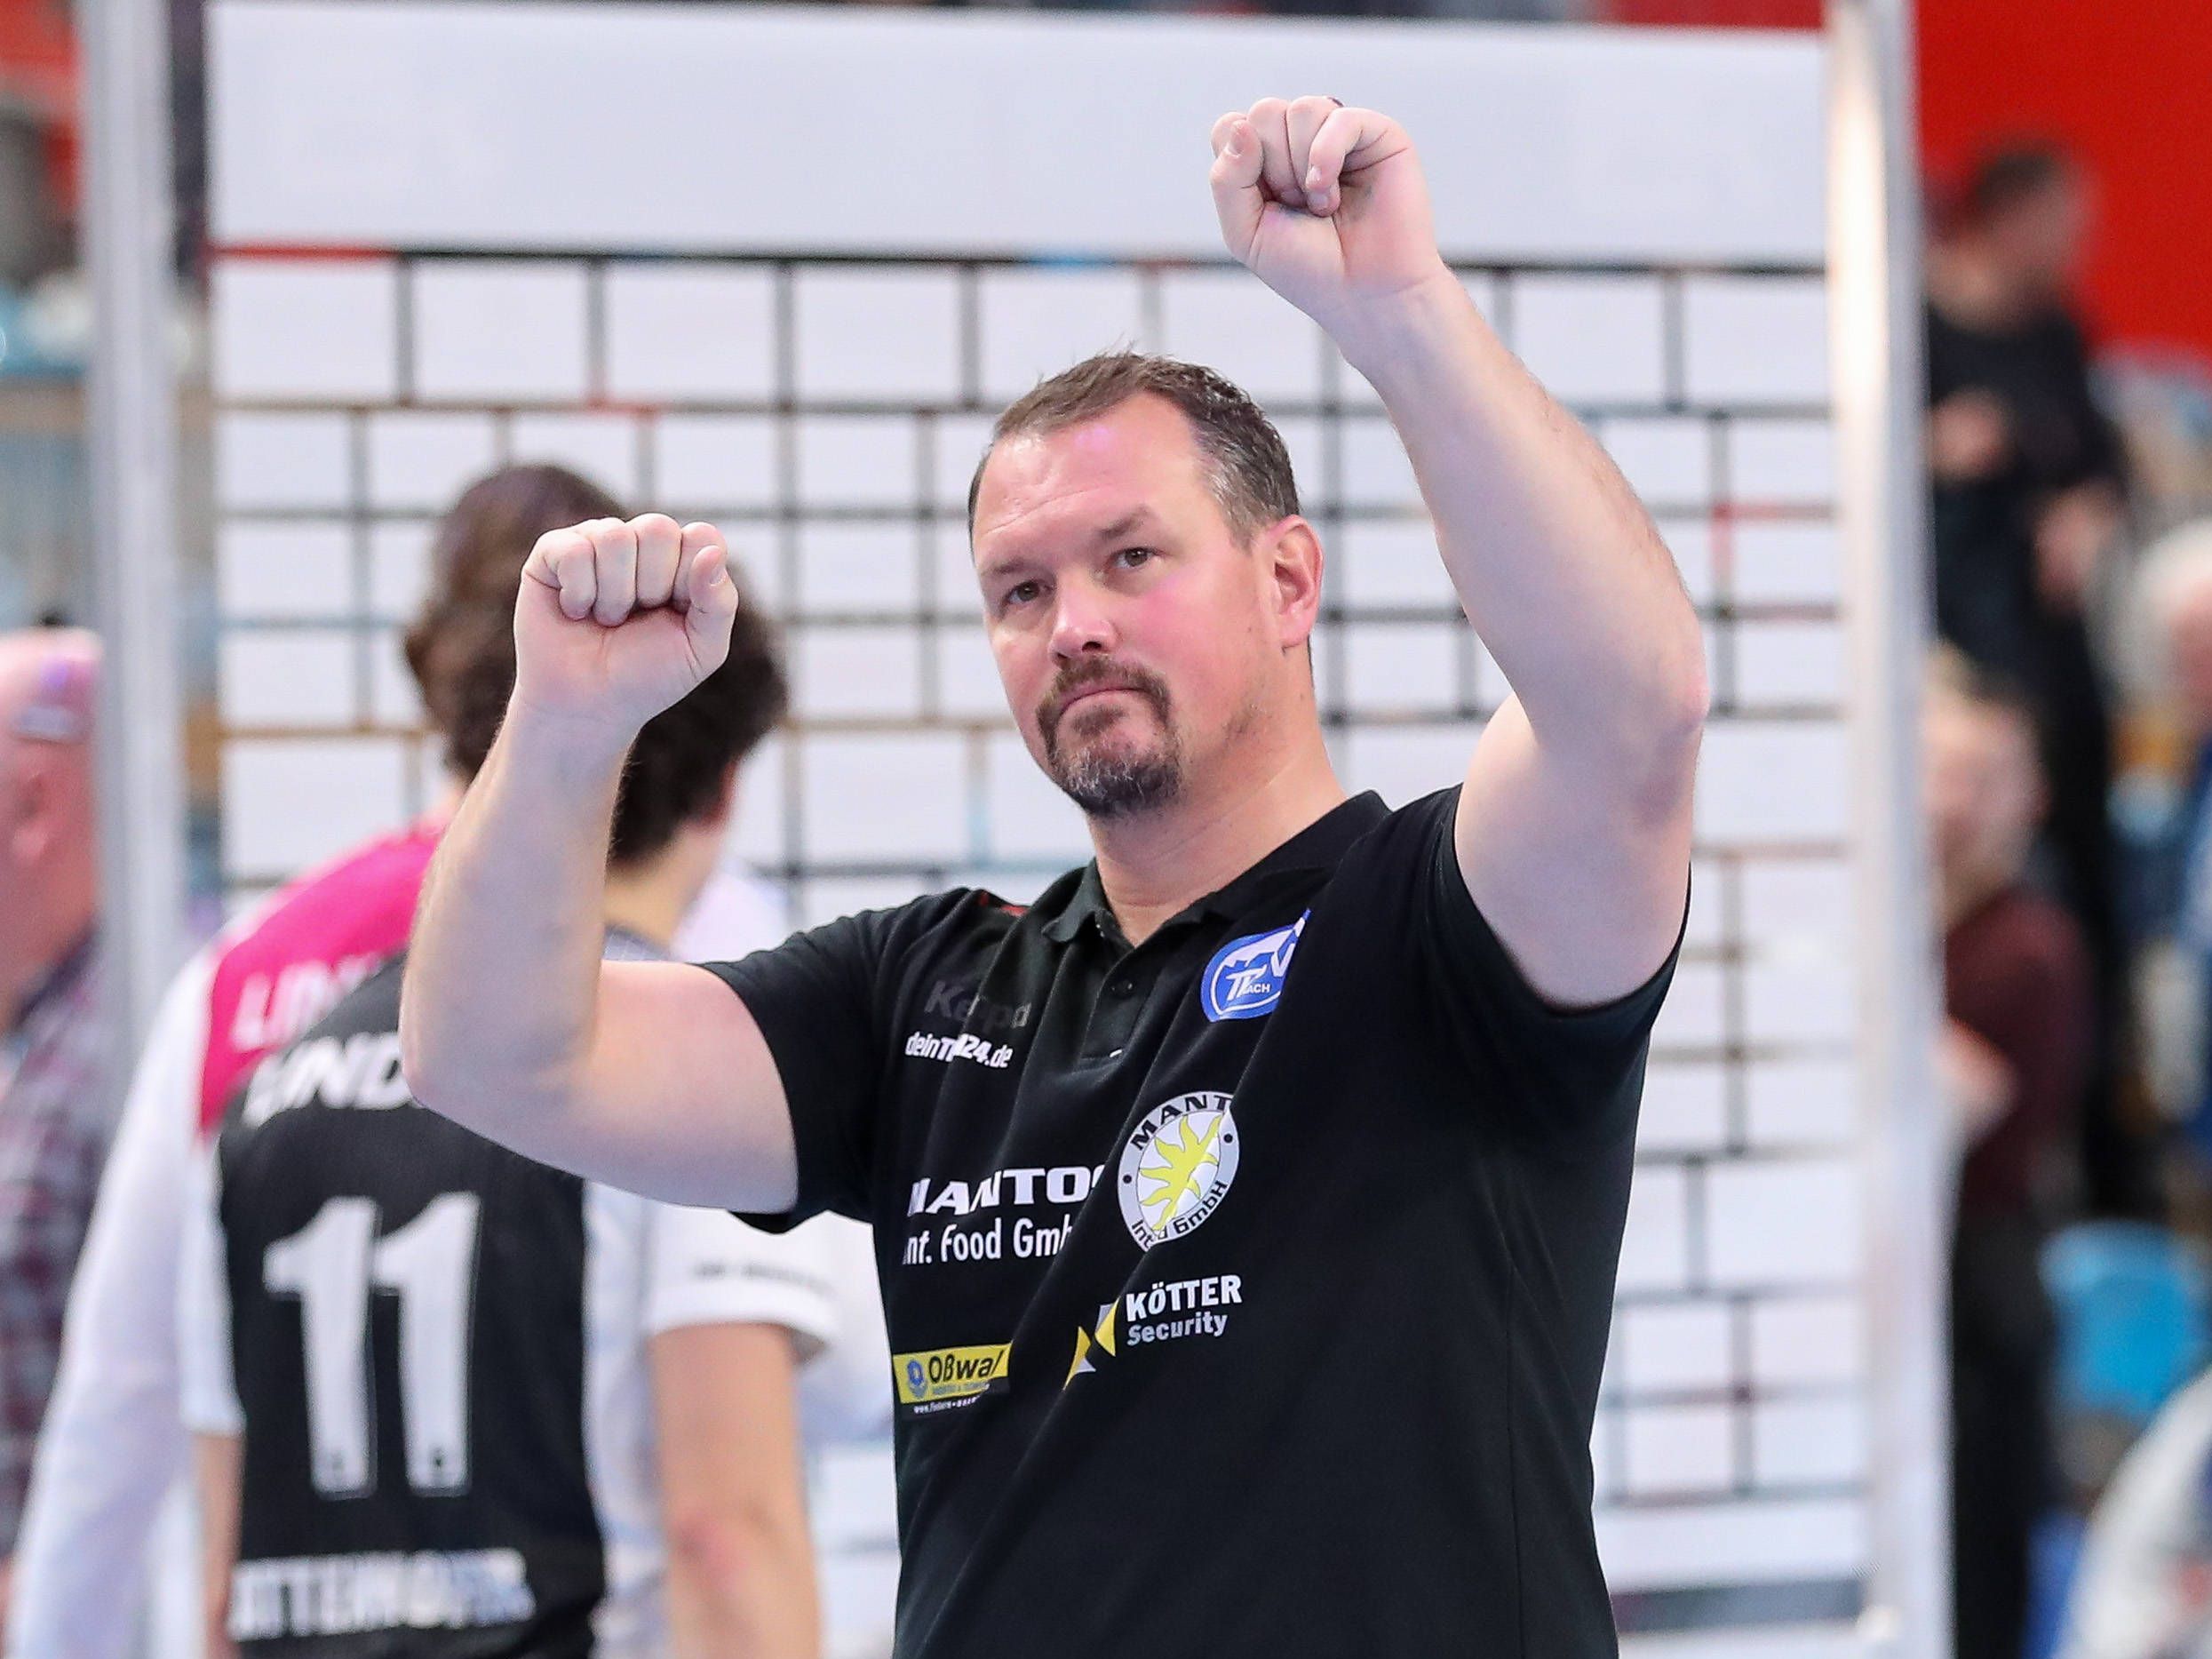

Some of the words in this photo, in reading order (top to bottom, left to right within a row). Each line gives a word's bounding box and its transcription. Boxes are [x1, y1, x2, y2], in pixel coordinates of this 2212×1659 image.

[1131, 1094, 1233, 1151] MANT
[907, 1164, 1105, 1217] ANTO
[1173, 1180, 1228, 1235] GmbH
[940, 1216, 1002, 1263] Food
[1126, 1274, 1243, 1322] KÖTTER
[264, 1191, 484, 1500] 11
[1126, 1311, 1228, 1346] Security
